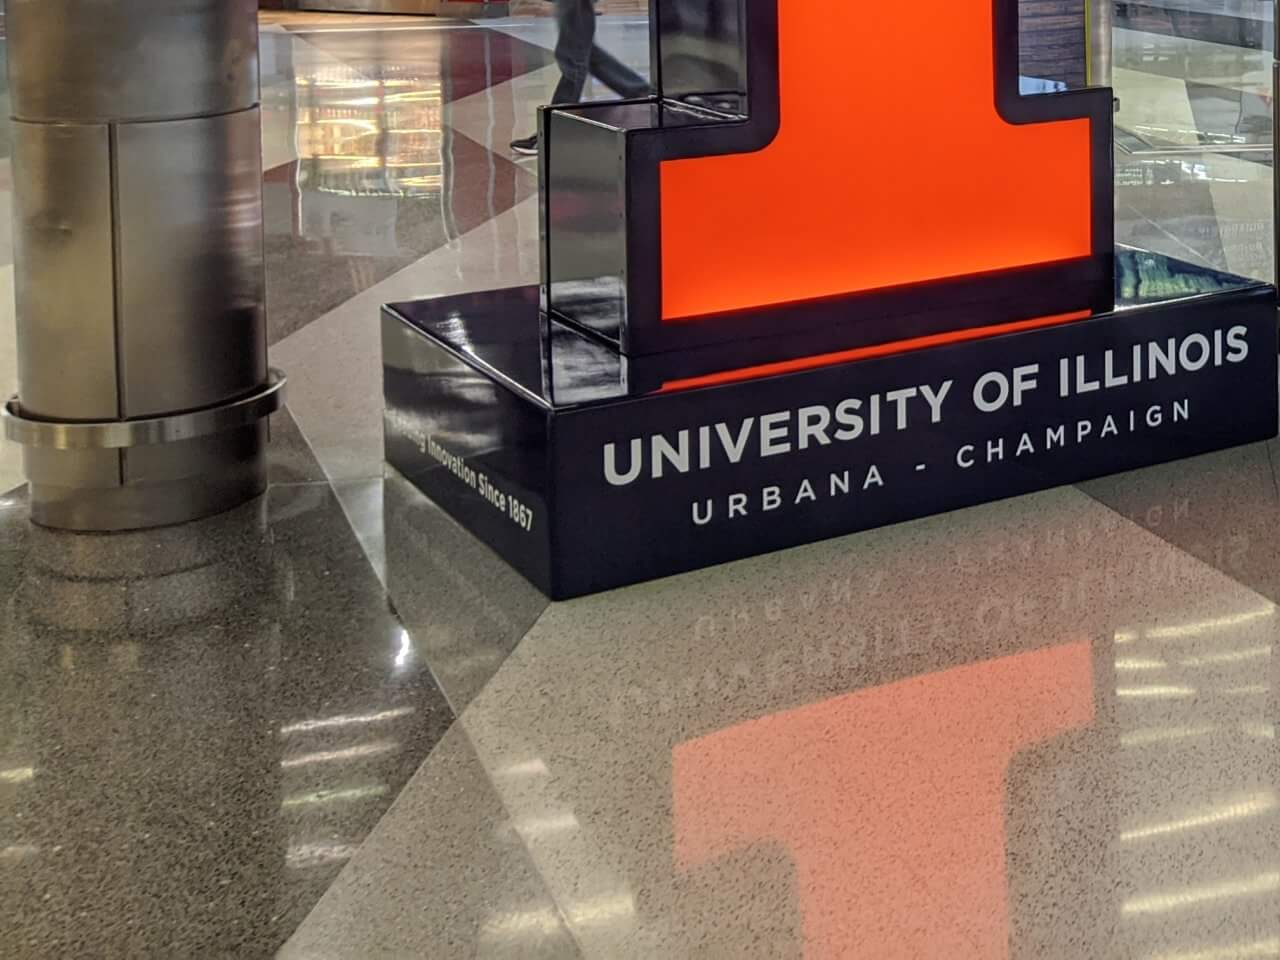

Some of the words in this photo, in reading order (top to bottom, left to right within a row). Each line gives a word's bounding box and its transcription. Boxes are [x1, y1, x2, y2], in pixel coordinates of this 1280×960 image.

[603, 379, 953, 487] UNIVERSITY
[972, 363, 1040, 413] OF
[1059, 325, 1249, 398] ILLINOIS
[691, 464, 884, 525] URBANA
[956, 398, 1189, 468] CHAMPAIGN
[427, 432, 477, 489] Innovation
[478, 473, 506, 512] Since
[508, 495, 533, 532] 1867
